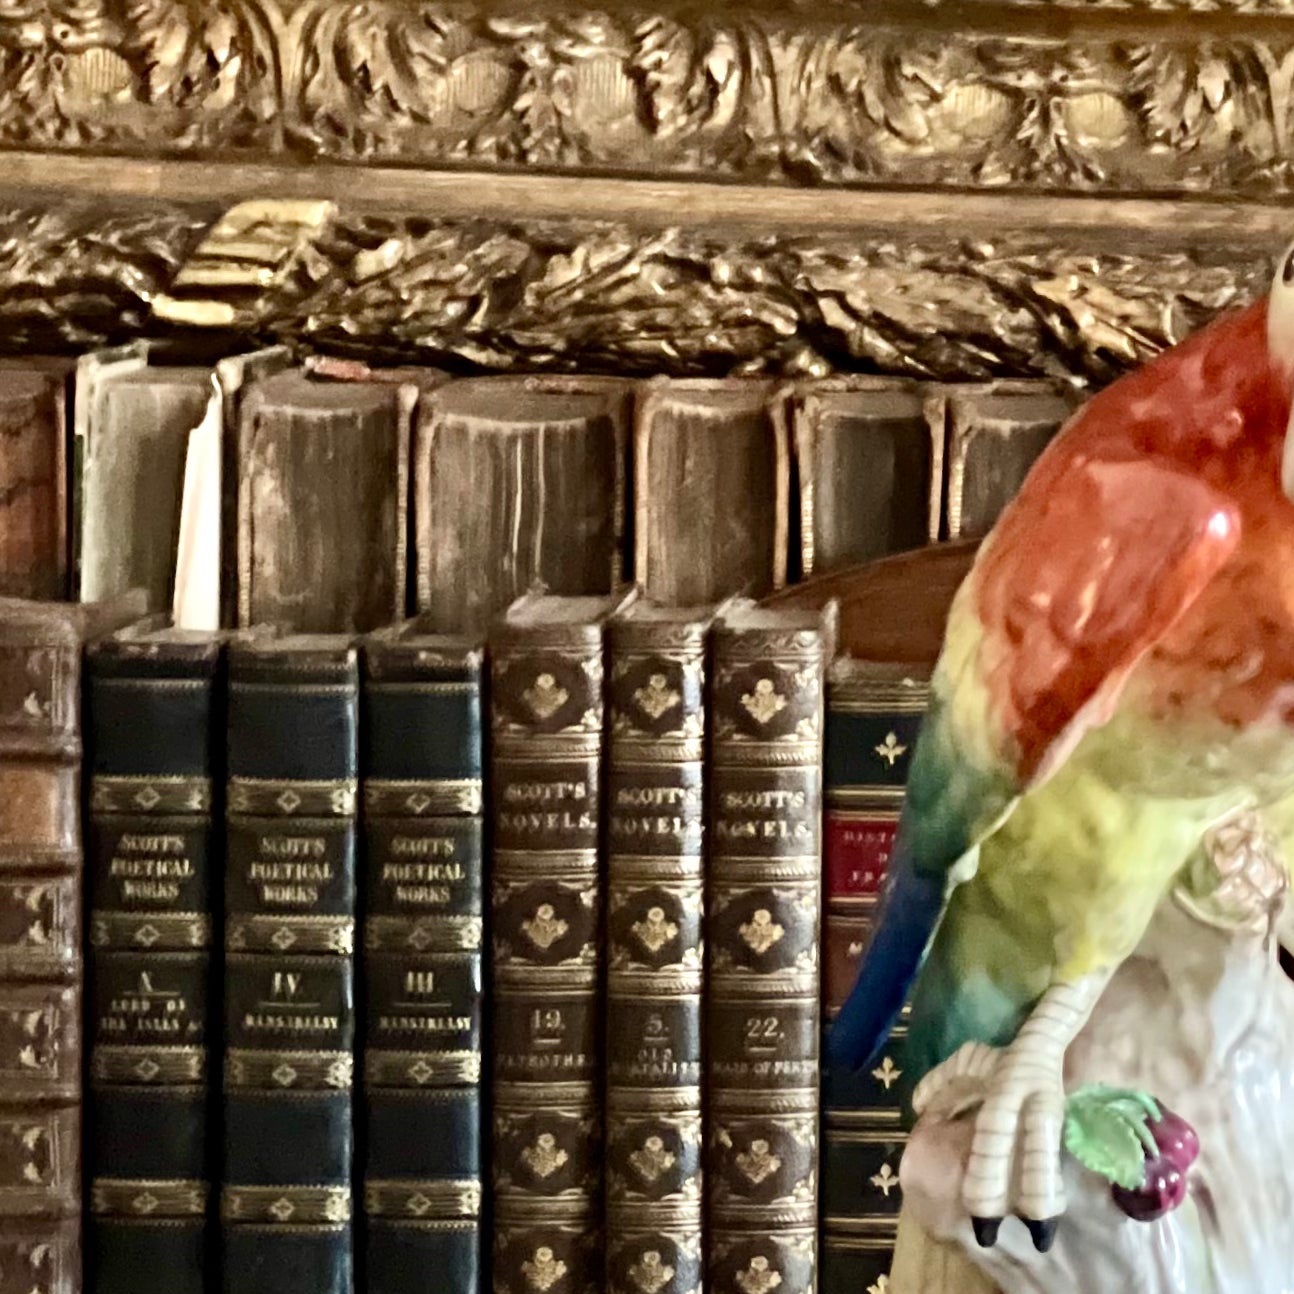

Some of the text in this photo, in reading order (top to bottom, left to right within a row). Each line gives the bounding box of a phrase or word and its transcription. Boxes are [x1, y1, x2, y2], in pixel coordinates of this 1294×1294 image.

[505, 782, 587, 800] SCOTT'S
[110, 858, 195, 876] POETICAL
[248, 863, 334, 880] POETICAL
[382, 863, 466, 881] POETICAL
[262, 885, 319, 902] WORKS
[272, 971, 301, 995] IV
[406, 971, 434, 994] III
